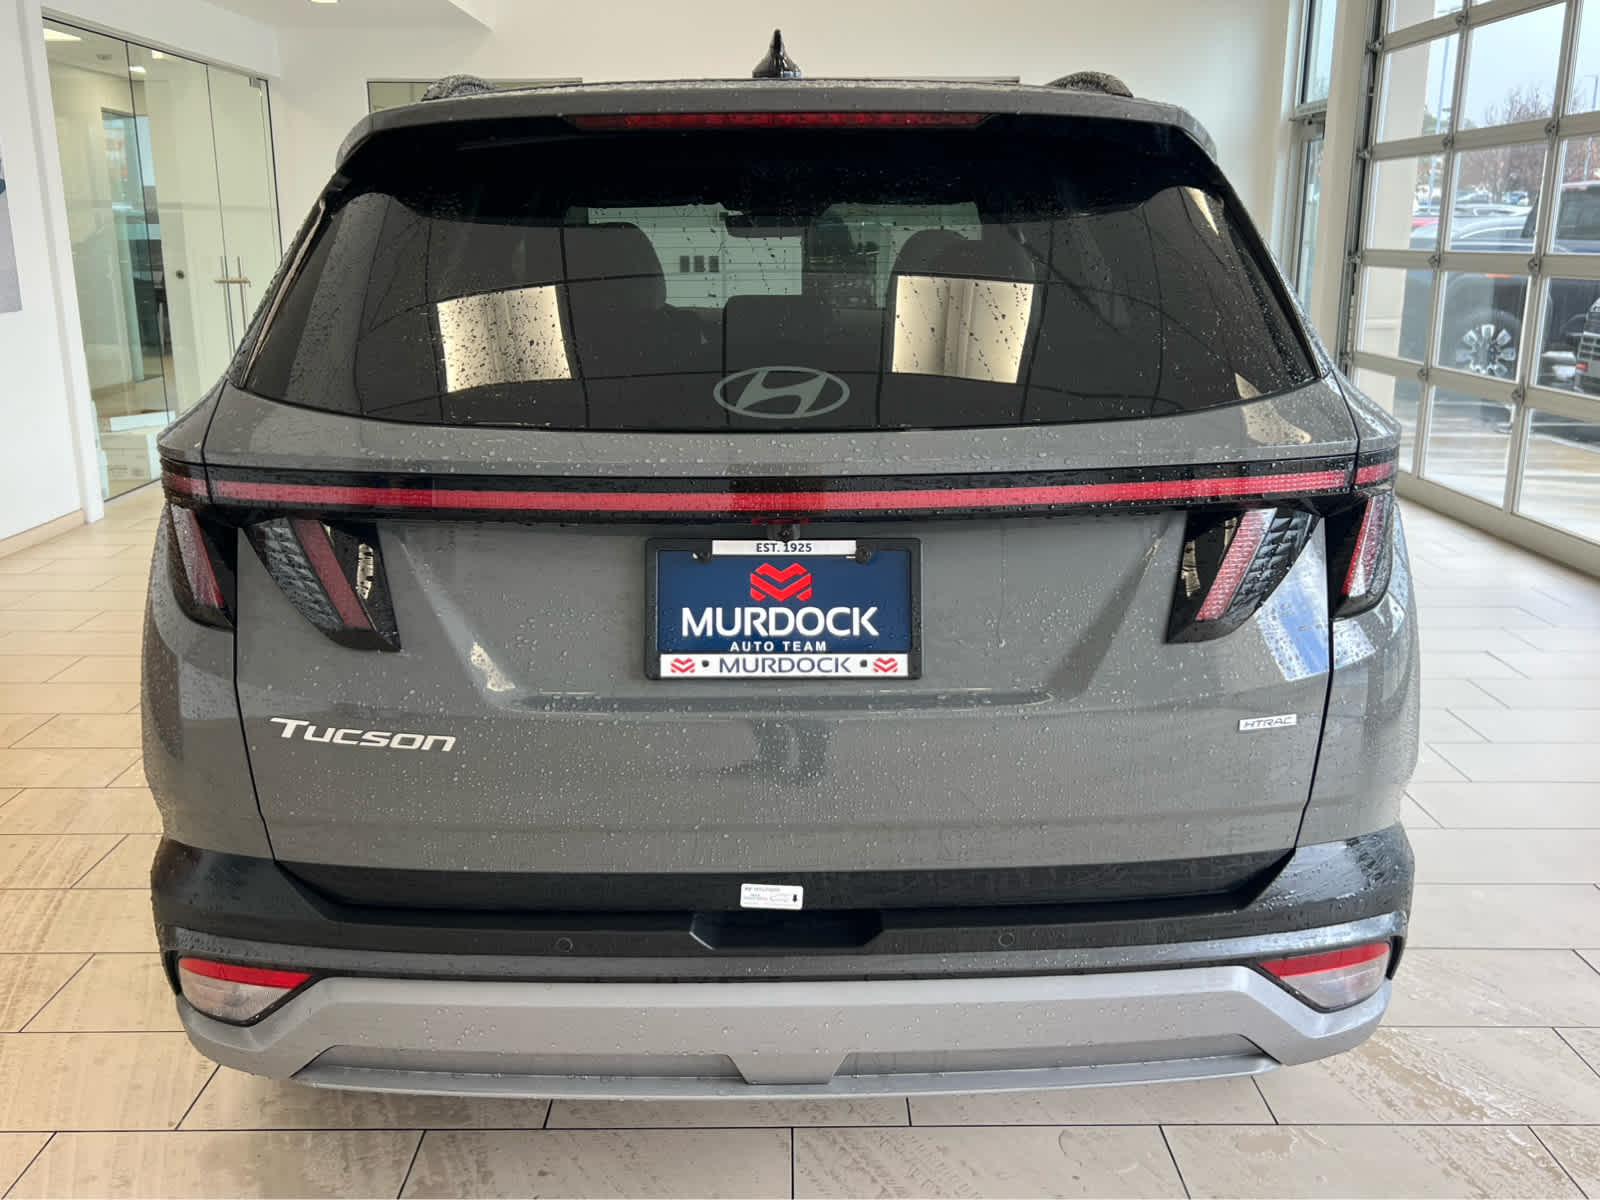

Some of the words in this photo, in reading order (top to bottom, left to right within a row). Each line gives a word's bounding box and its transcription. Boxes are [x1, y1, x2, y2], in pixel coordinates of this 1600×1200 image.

[756, 542, 781, 553] EST.
[783, 542, 813, 553] 1925
[681, 606, 880, 637] MURDOCK
[730, 640, 774, 652] AUTO
[782, 640, 827, 652] TEAM
[719, 657, 852, 674] MURDOCK
[1243, 716, 1295, 728] HTRAC
